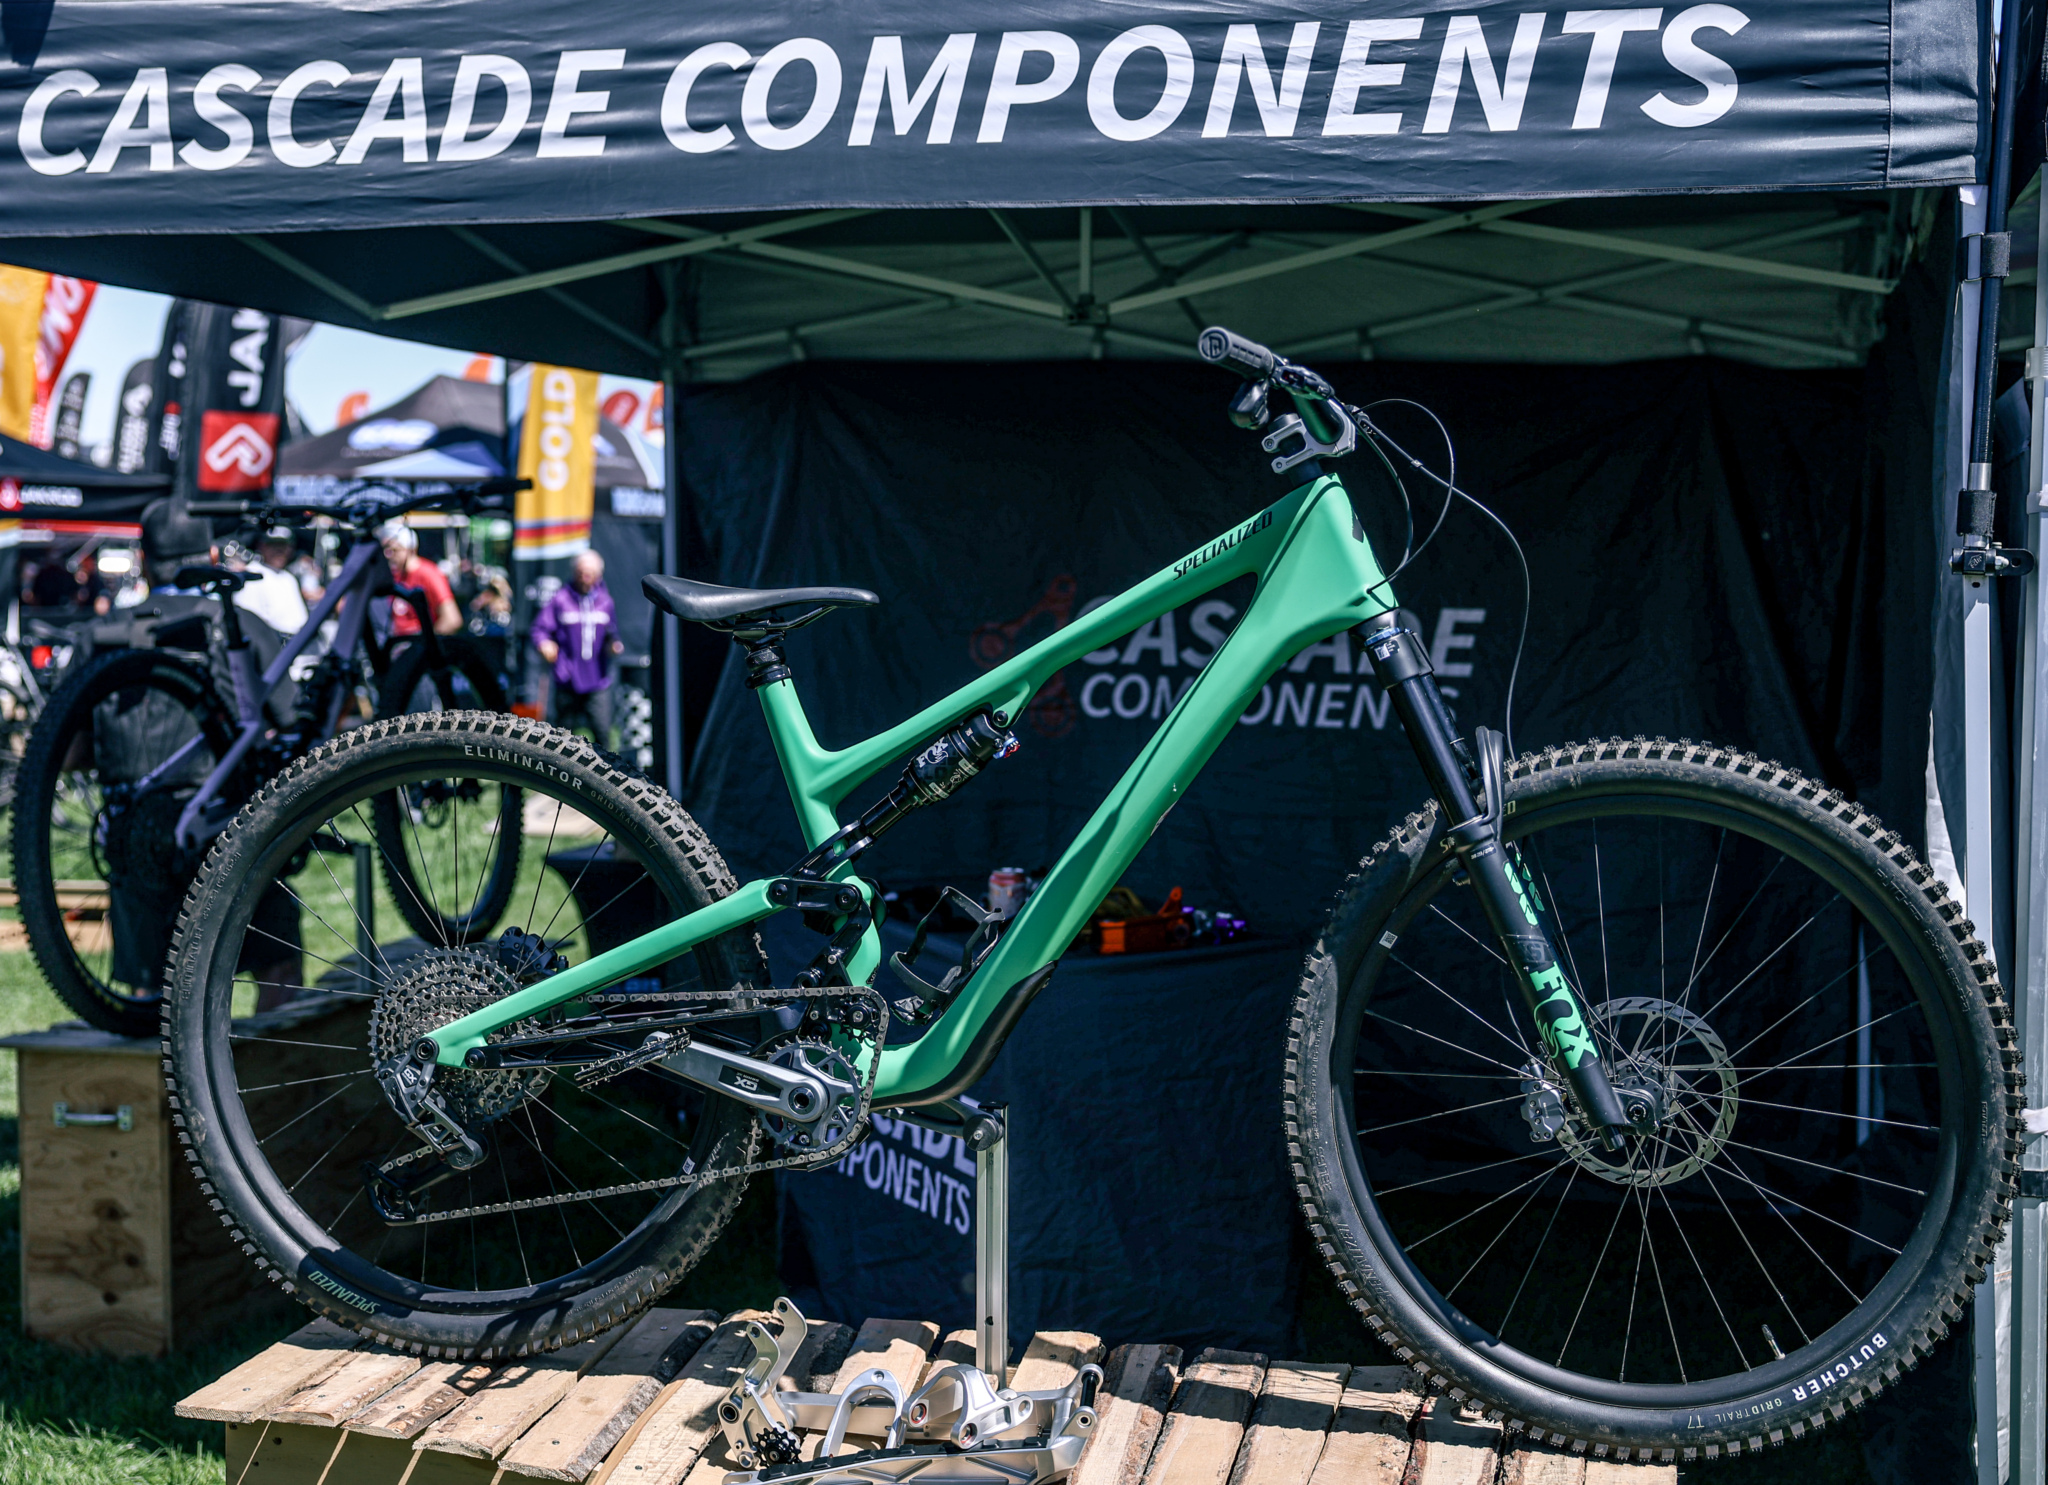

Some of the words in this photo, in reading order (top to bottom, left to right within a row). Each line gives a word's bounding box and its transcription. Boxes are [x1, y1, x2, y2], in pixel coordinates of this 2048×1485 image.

[17, 48, 627, 177] CASCADE
[659, 3, 1750, 154] COMPONENTS
[538, 369, 577, 491] GOLD
[1172, 510, 1273, 581] SPECIALIZED
[464, 744, 584, 791] ELIMINATOR
[917, 735, 949, 769] FOX
[1529, 960, 1600, 1070] FOX
[733, 1075, 759, 1092] GX
[307, 1269, 381, 1315] SPECIALIZED
[1791, 1332, 1889, 1402] BUTCHER
[1687, 1414, 1705, 1430] T7
